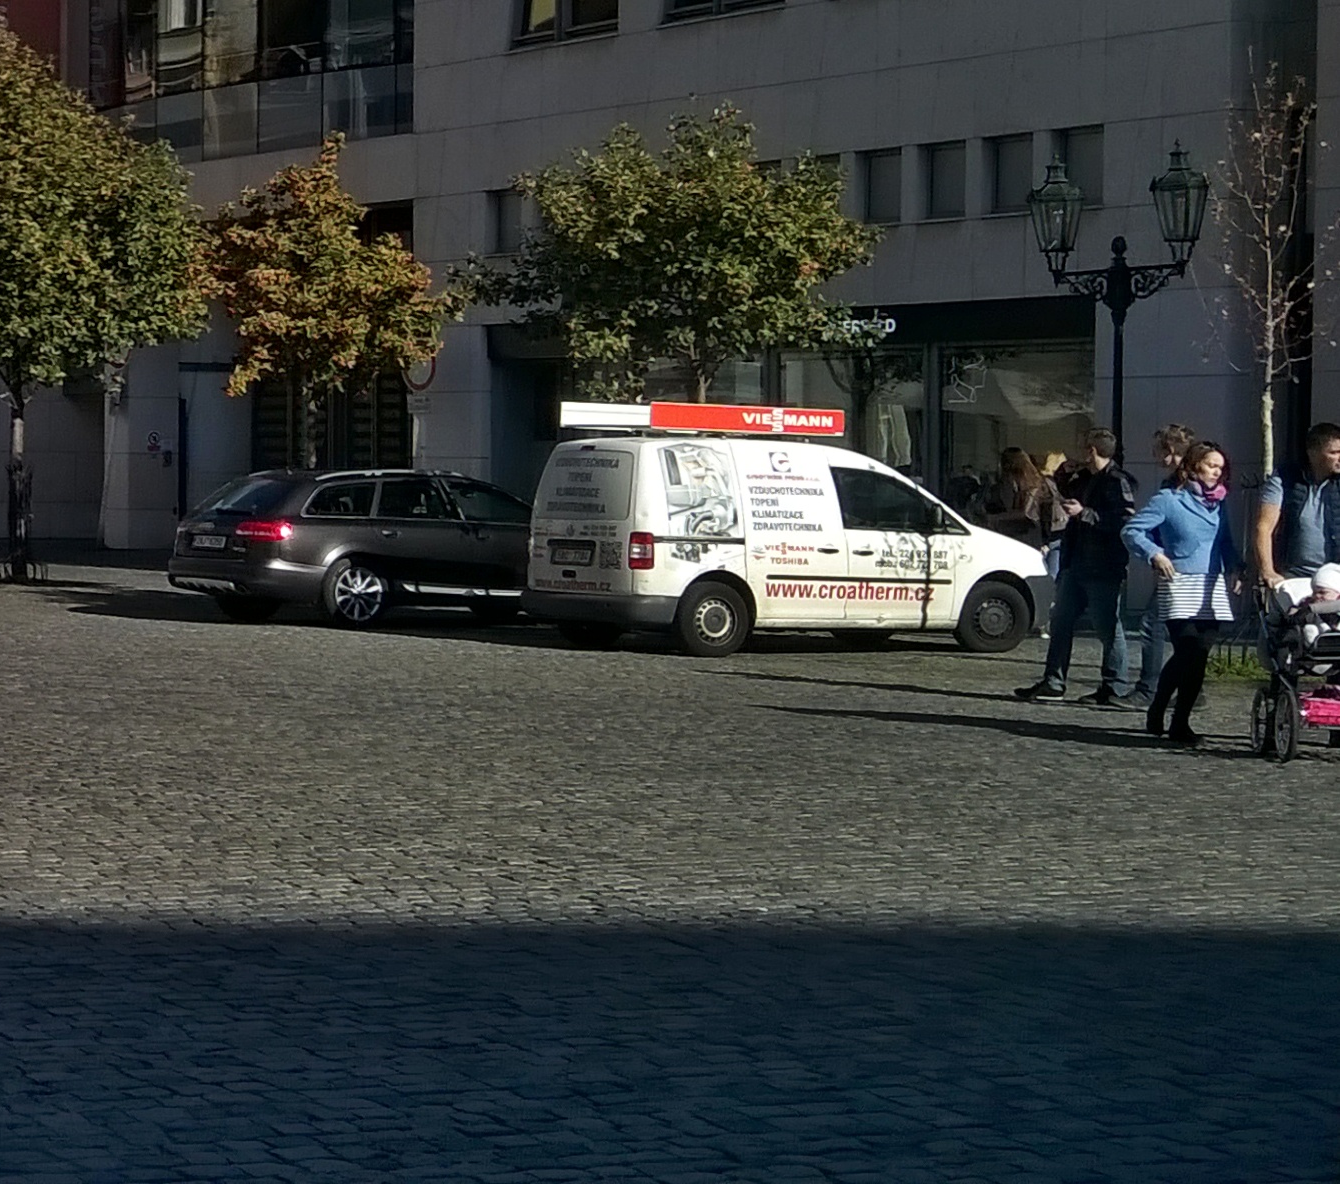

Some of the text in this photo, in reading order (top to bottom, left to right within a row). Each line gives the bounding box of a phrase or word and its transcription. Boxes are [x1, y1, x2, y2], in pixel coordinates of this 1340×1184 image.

[742, 409, 833, 432] VIESSMANN
[750, 497, 779, 507] TOPENÍ
[751, 510, 804, 519] KLIMATIZACE
[753, 522, 824, 532] ZDRAVOTECHNIKA
[770, 557, 809, 566] TOSHIBA
[765, 581, 935, 602] www.croatherm.cz
